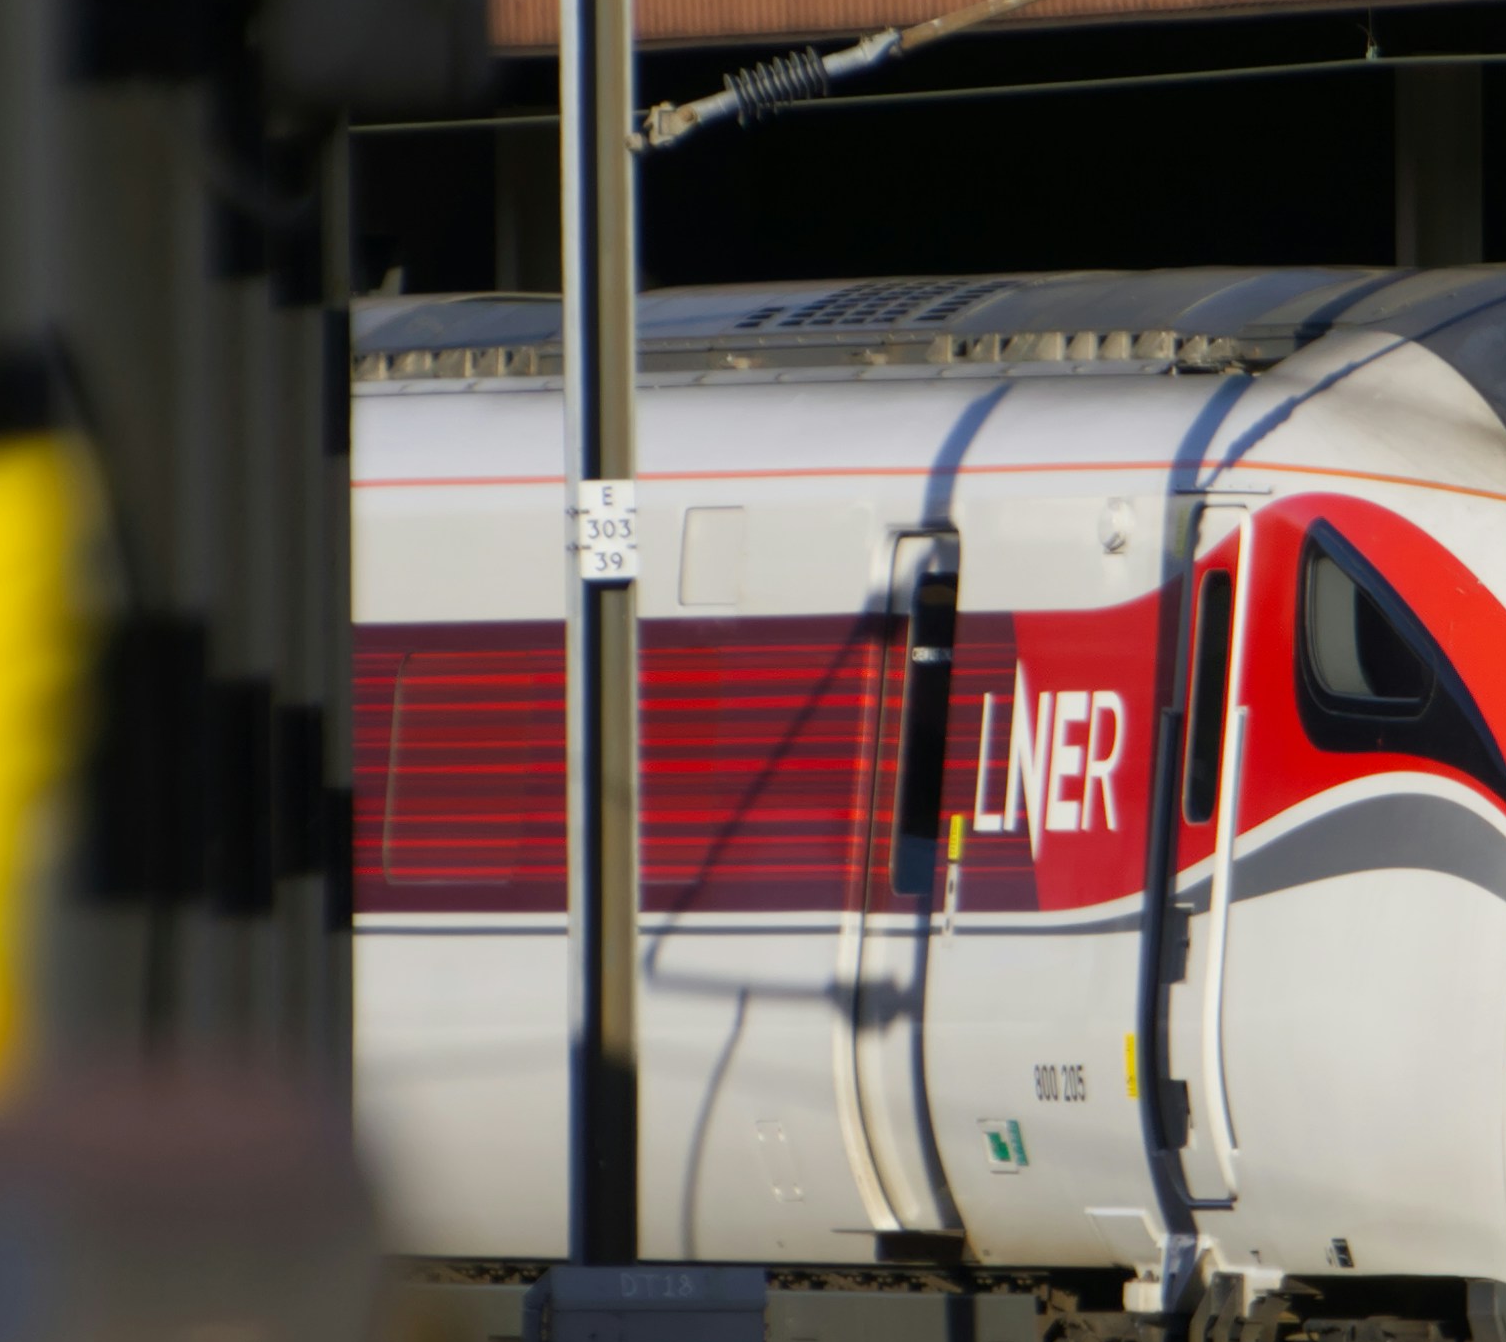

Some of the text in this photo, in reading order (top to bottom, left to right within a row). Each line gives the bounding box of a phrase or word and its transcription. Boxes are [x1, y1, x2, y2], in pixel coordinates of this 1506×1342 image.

[601, 485, 614, 506] E
[586, 519, 632, 539] 303
[594, 551, 624, 571] 39
[973, 657, 1127, 863] LNER
[1034, 1064, 1059, 1101] 800
[1061, 1064, 1087, 1102] 205
